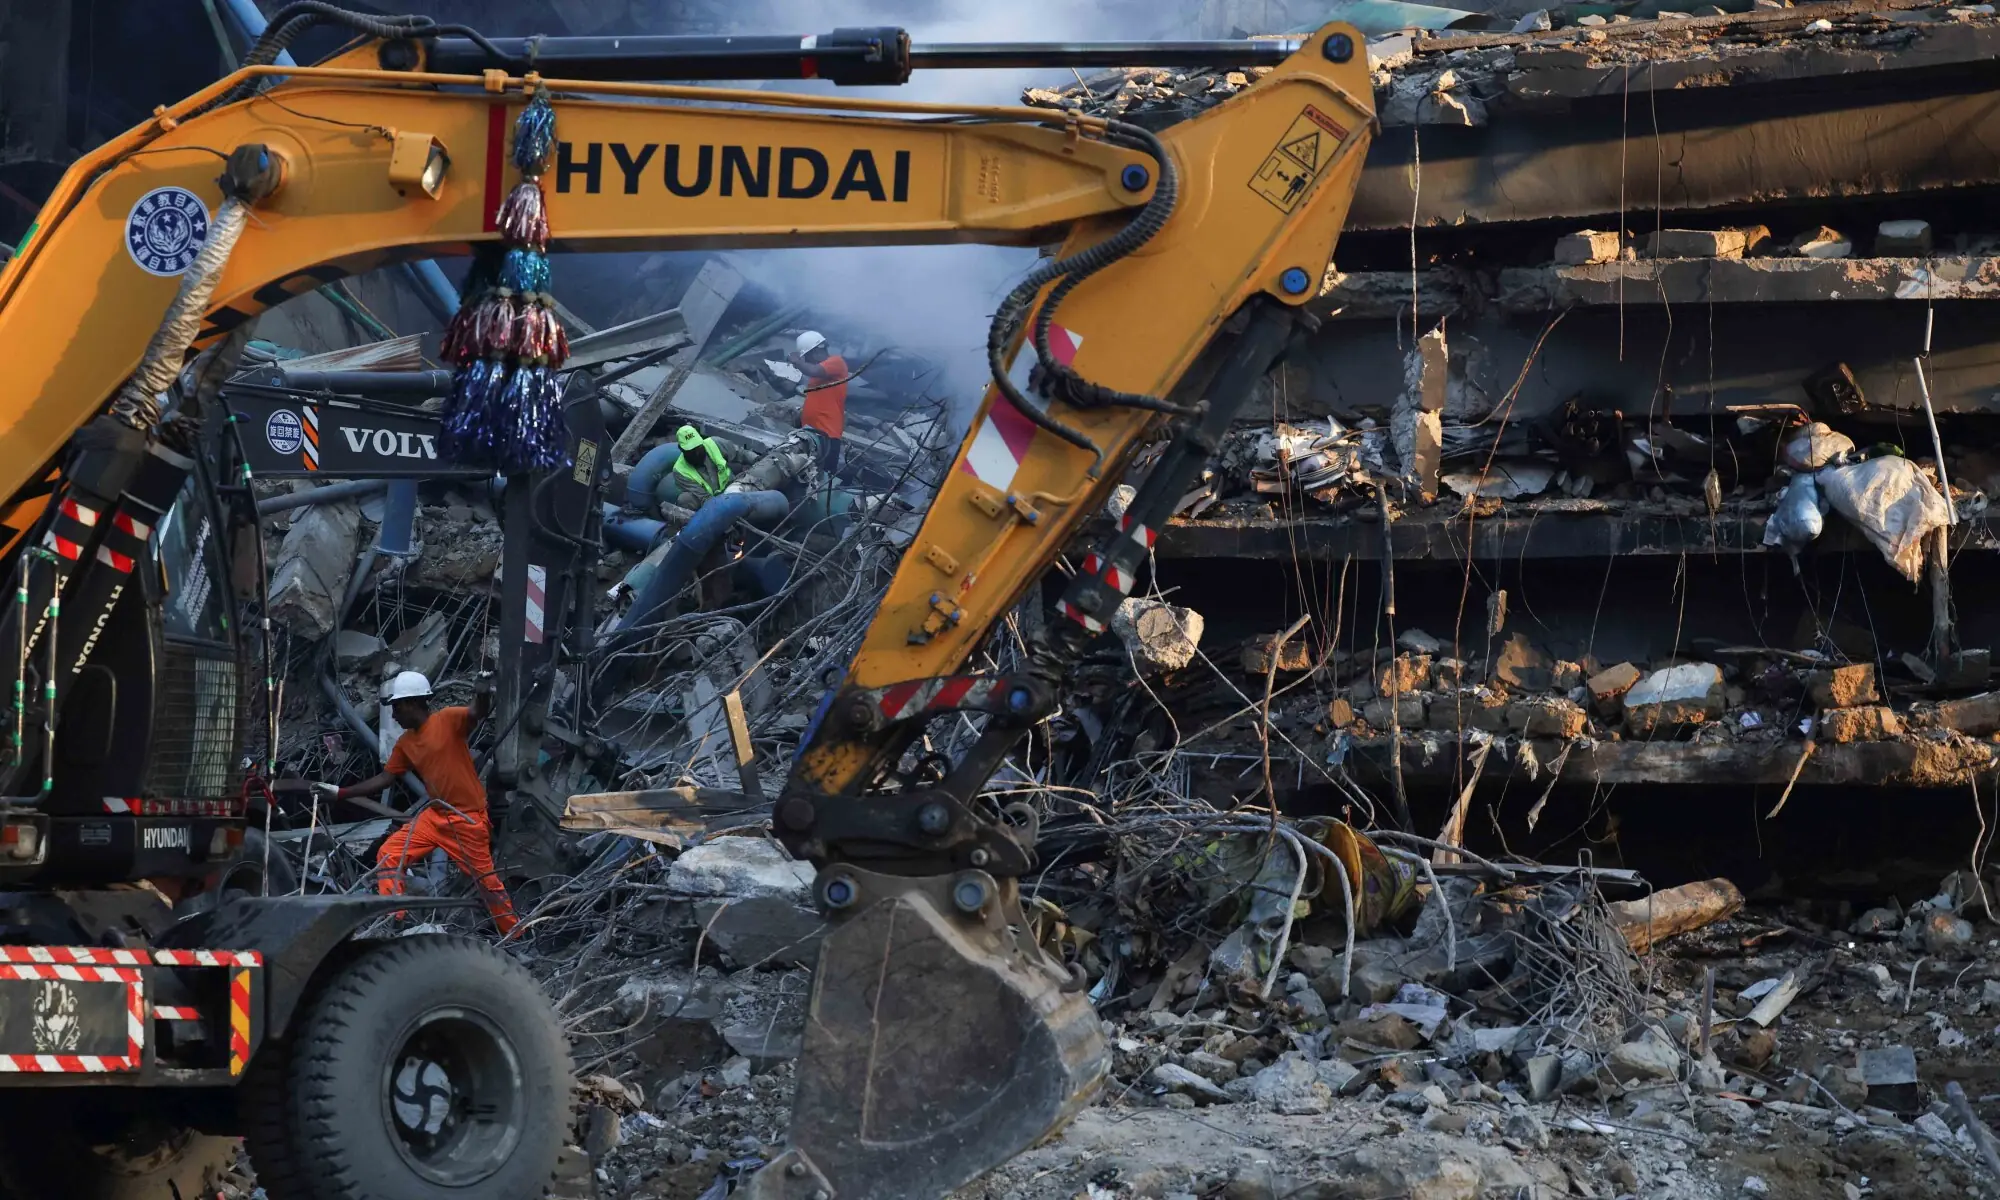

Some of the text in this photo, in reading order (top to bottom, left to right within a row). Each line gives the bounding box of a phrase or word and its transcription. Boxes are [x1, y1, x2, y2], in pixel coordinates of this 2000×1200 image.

[556, 142, 911, 203] HYUNDAI
[339, 426, 438, 460] VOLV
[71, 584, 124, 674] HYUNDAI
[143, 827, 187, 849] HYUNDAI
